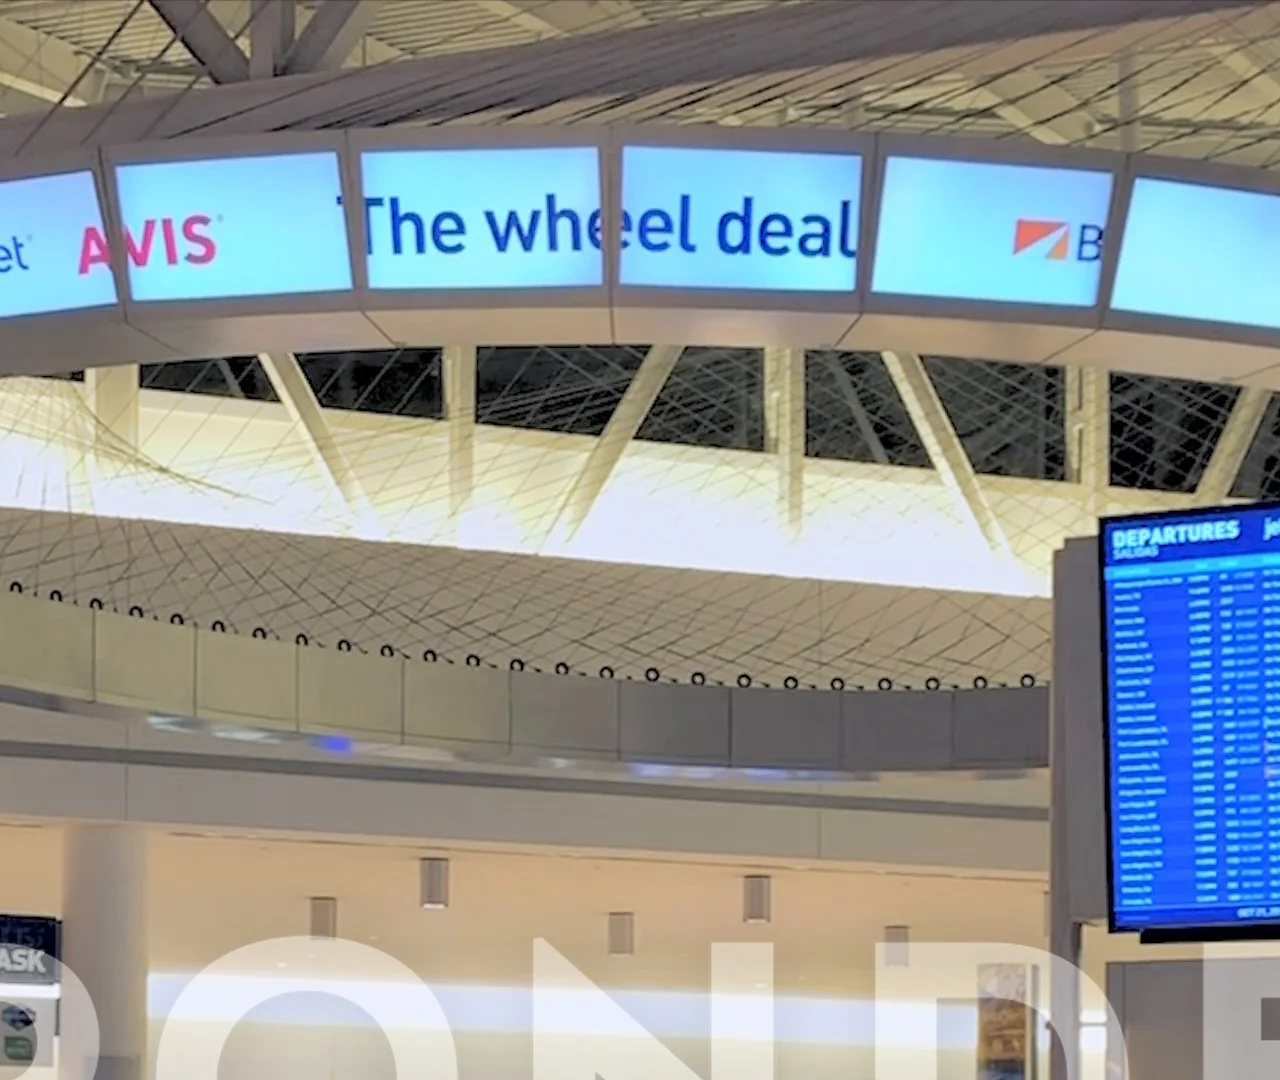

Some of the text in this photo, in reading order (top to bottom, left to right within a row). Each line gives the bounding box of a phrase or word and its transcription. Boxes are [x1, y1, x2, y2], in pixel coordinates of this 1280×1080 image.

[77, 214, 217, 277] AVIS
[336, 195, 467, 257] The
[484, 192, 696, 254] wheel
[1111, 518, 1241, 549] DEPARTURES
